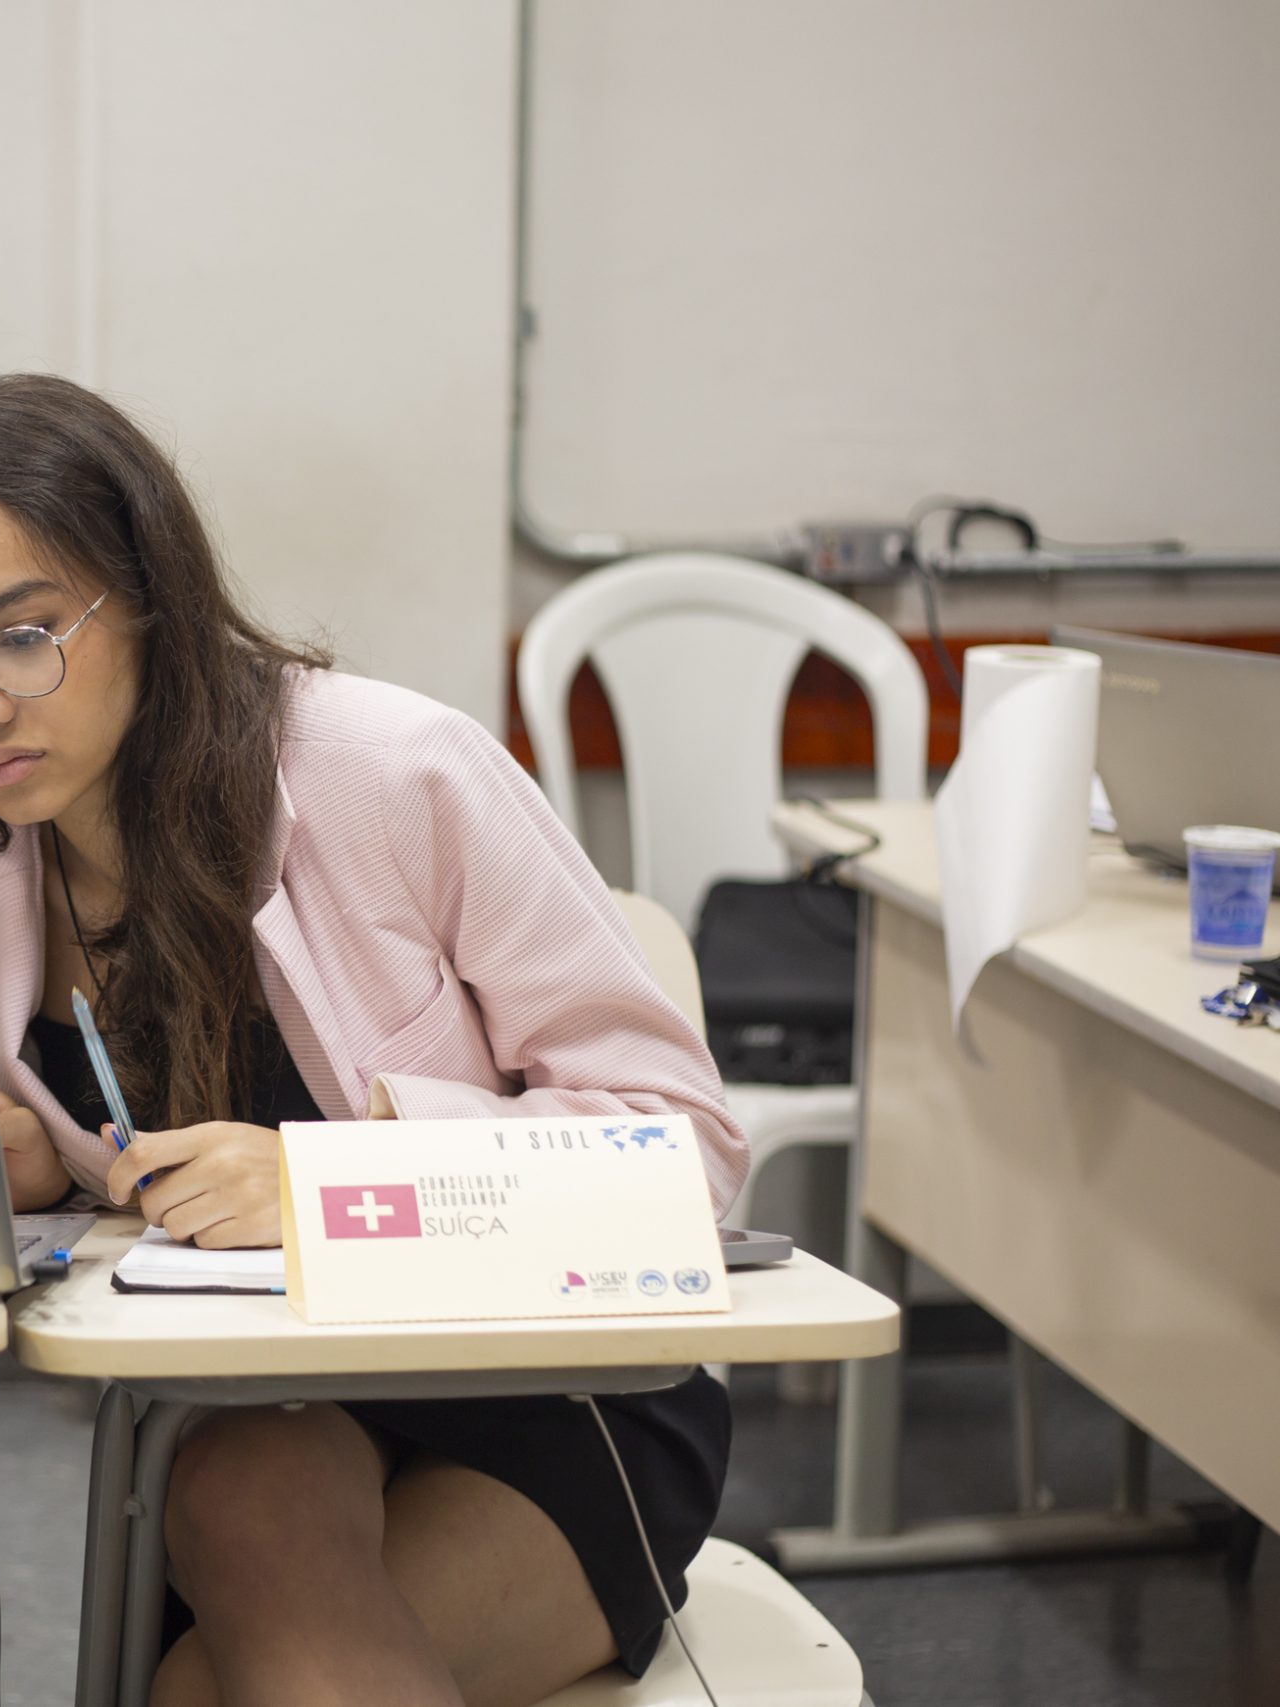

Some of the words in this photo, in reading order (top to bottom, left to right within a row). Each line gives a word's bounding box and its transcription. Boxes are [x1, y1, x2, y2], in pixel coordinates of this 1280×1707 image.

[494, 1131, 505, 1150] V
[528, 1130, 591, 1150] SIOL
[418, 1174, 494, 1190] CONSELHO
[503, 1174, 521, 1188] DE
[422, 1191, 508, 1208] SEGURANÇA
[424, 1211, 509, 1240] SUÍÇA
